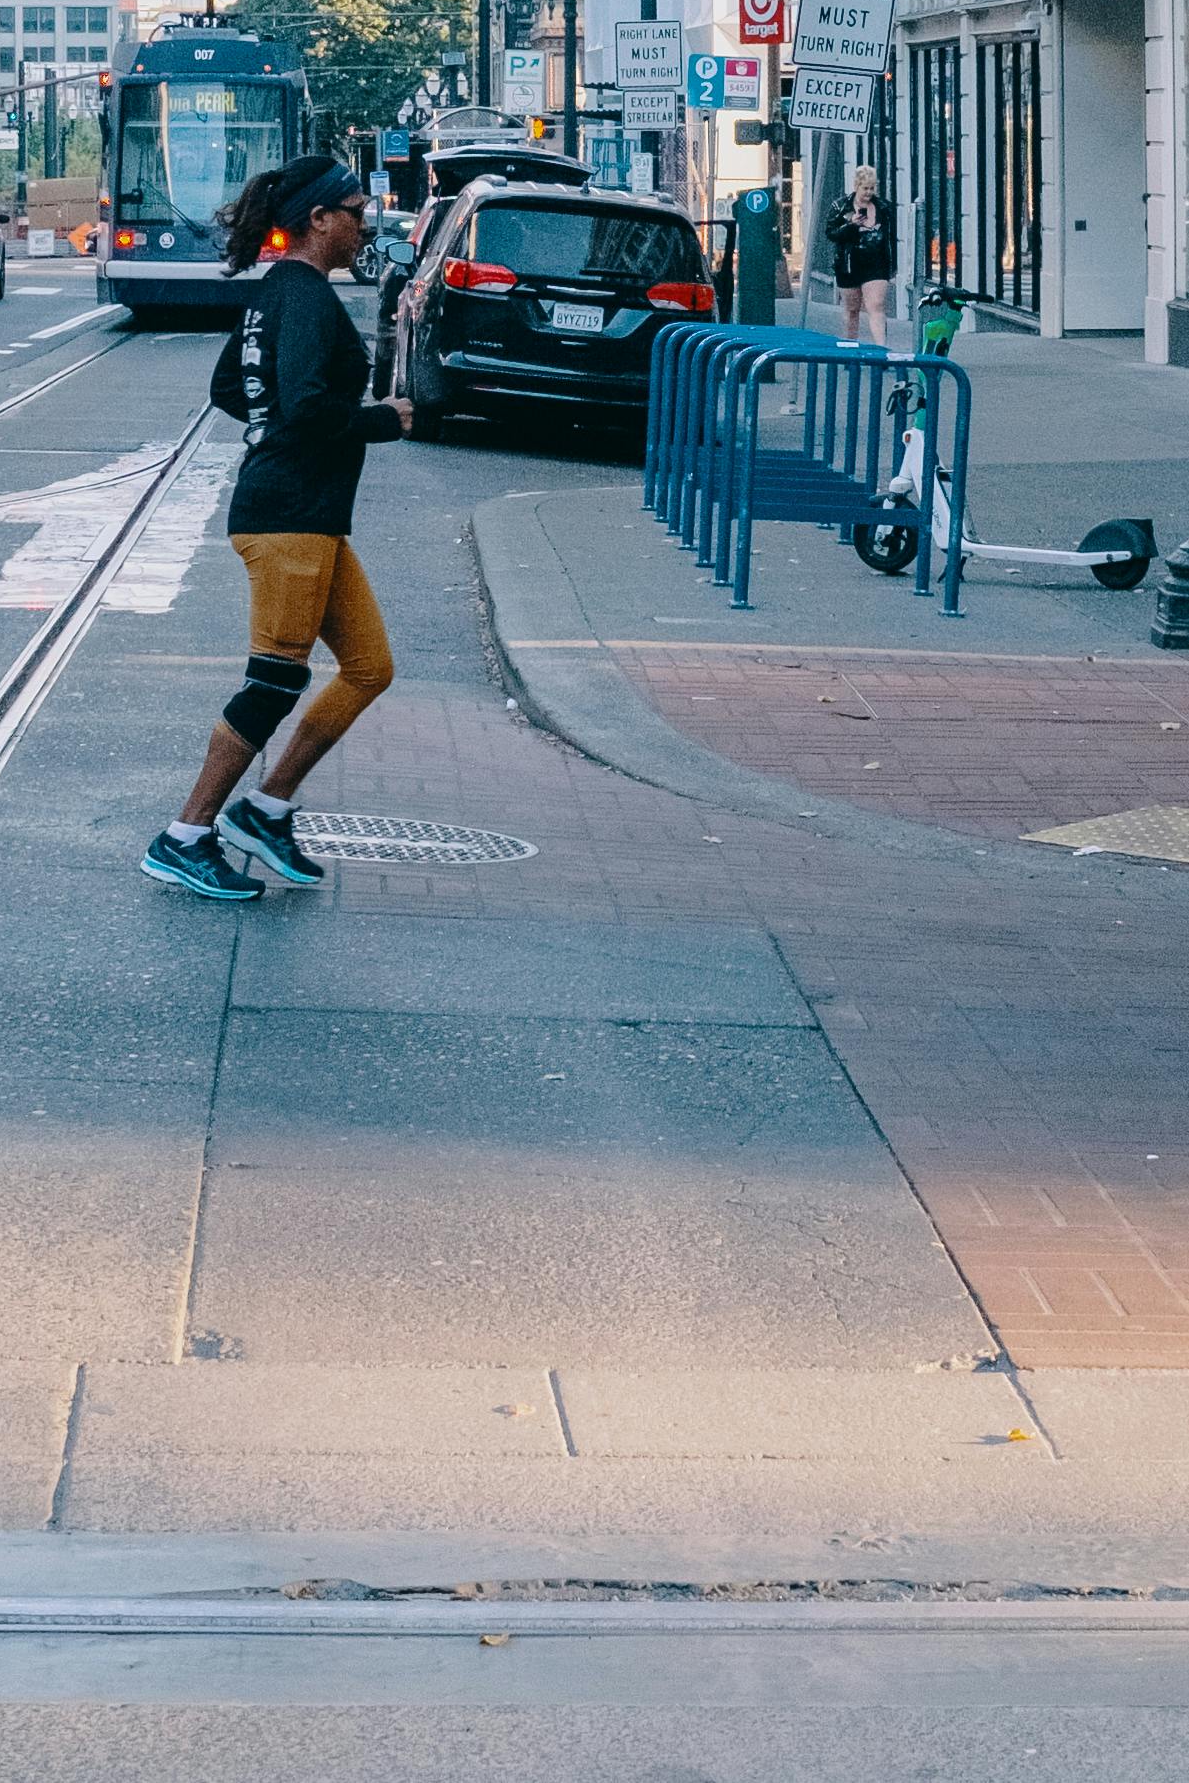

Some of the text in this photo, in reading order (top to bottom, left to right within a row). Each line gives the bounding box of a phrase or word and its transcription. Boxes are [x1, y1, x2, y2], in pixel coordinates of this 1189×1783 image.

[818, 6, 870, 29] MUST
[619, 28, 678, 40] RIGHT LANE
[744, 22, 779, 38] target
[194, 49, 215, 61] 007
[631, 46, 667, 60] MUST
[800, 35, 885, 59] TURN RIGHT
[620, 66, 680, 79] TURN RIGHT
[699, 81, 714, 102] 2
[805, 79, 863, 99] EXCEPT
[195, 91, 238, 113] PEARL
[631, 97, 670, 108] EXCEPT
[626, 111, 674, 123] STREETCAR
[797, 101, 865, 123] STREETCAR
